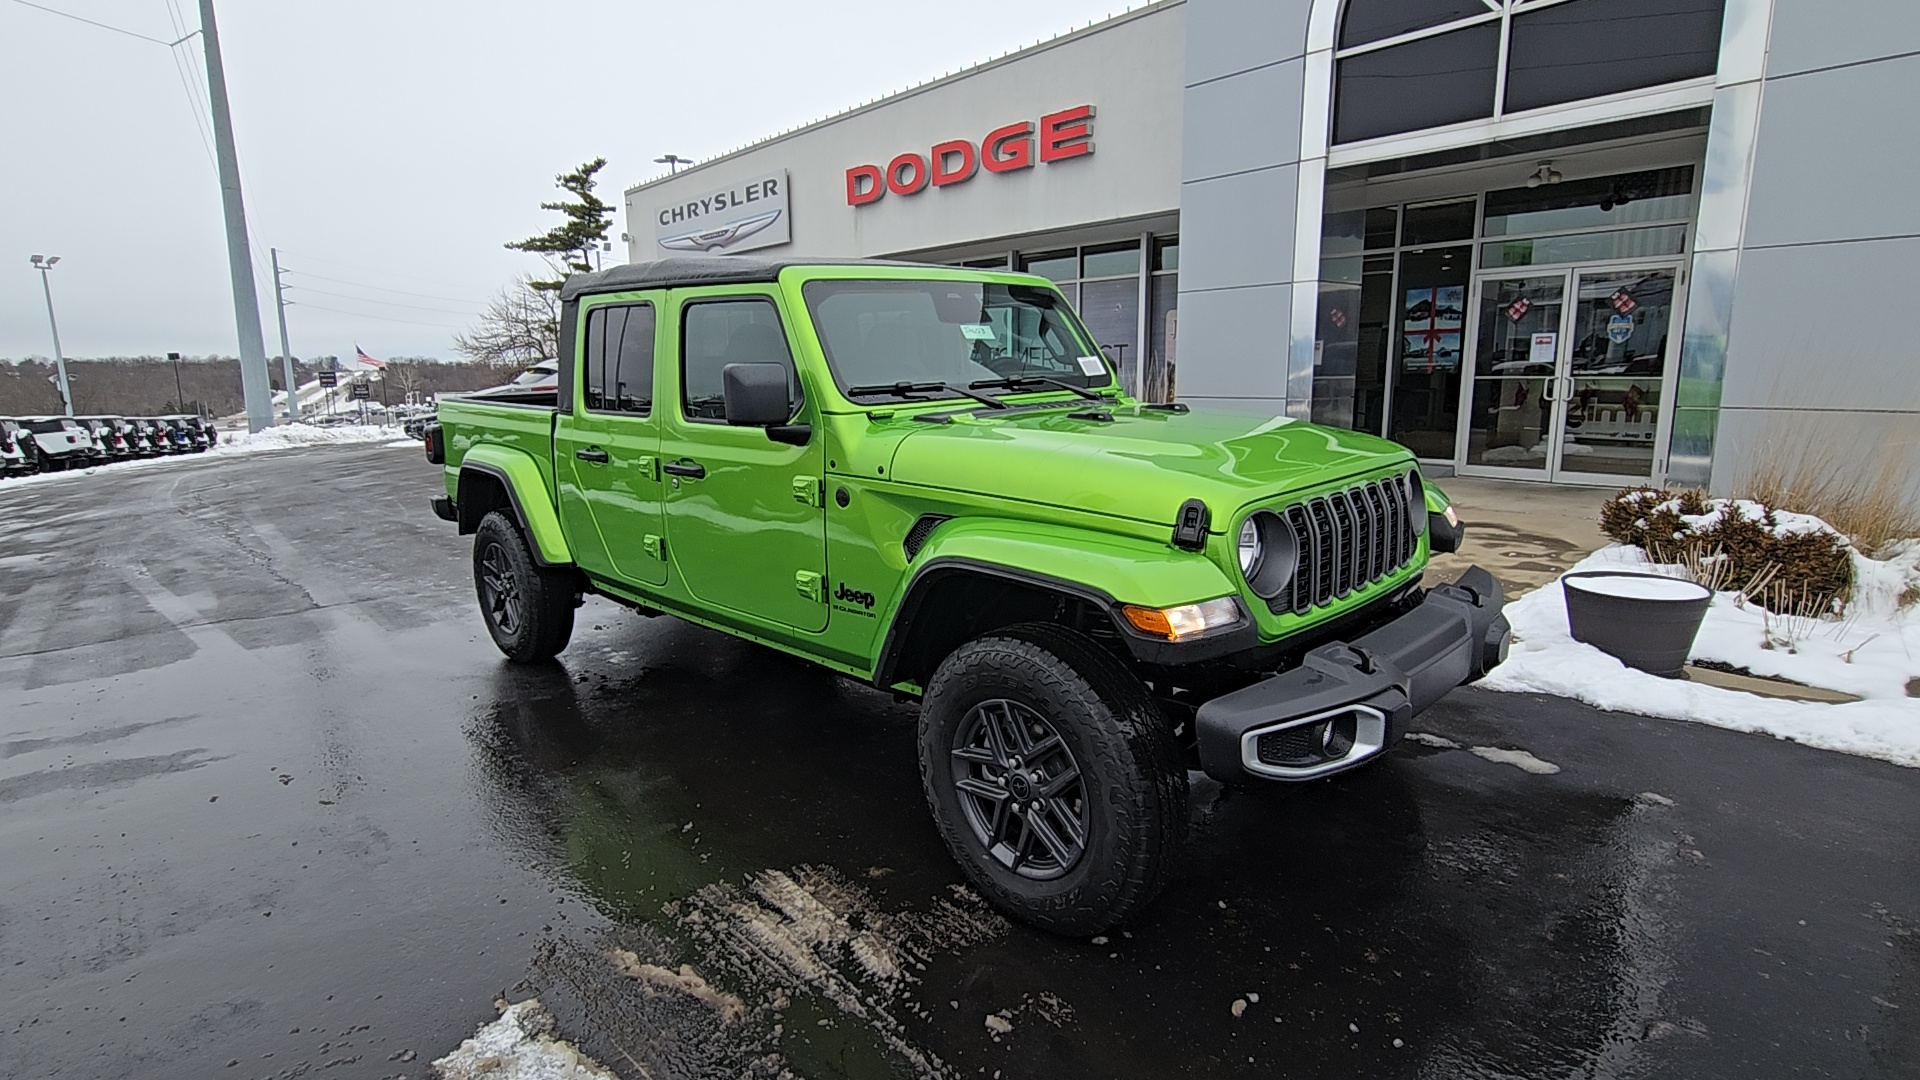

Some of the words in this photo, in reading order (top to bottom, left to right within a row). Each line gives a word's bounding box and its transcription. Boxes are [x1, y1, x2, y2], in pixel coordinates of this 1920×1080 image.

[846, 104, 1095, 206] DODGE
[659, 179, 779, 226] CHRYSLER
[834, 582, 875, 610] Jeep
